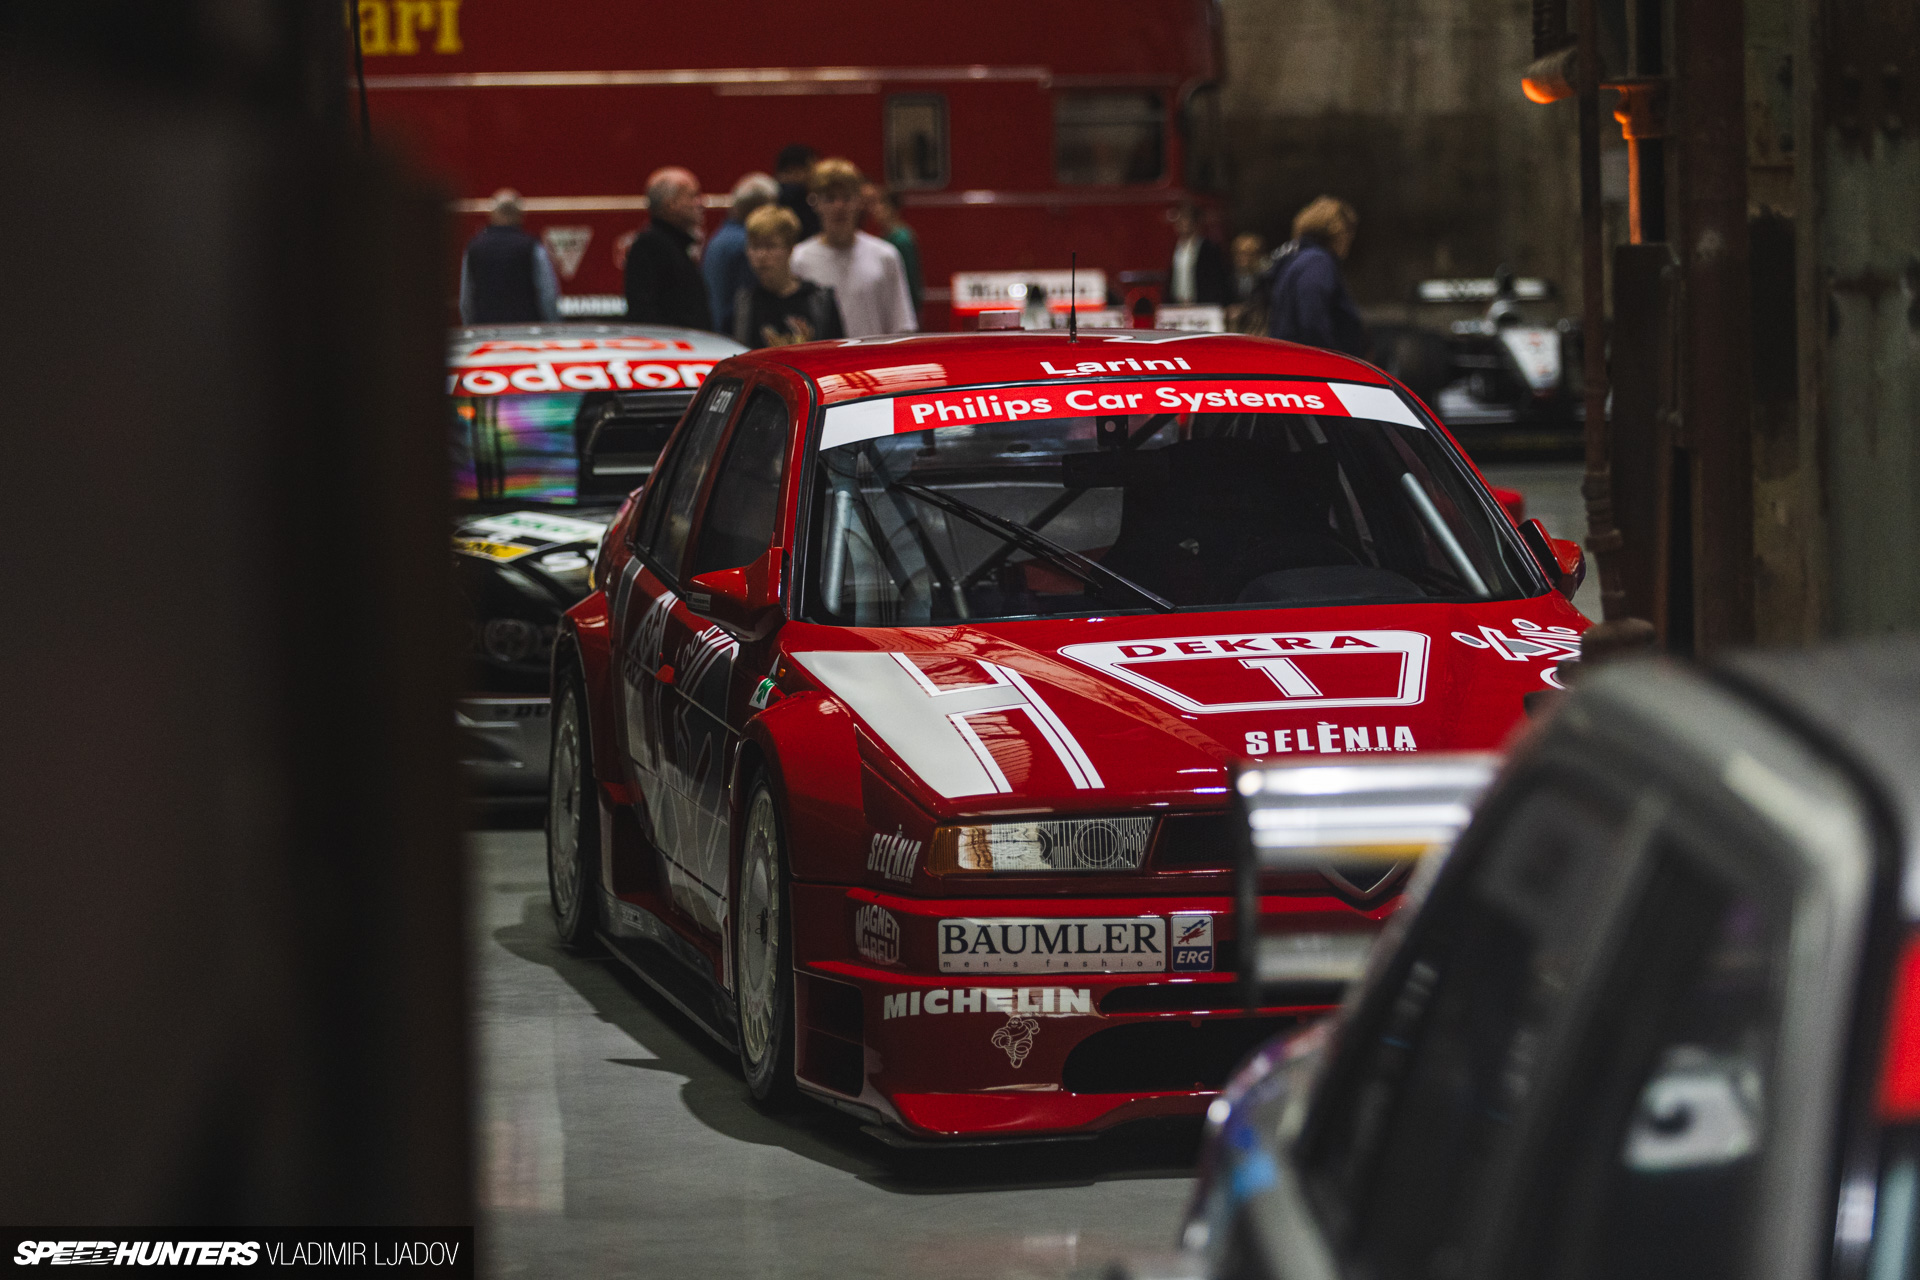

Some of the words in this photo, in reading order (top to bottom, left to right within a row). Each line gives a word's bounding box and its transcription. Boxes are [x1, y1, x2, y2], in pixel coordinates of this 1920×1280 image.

[344, 0, 464, 55] ari
[449, 361, 716, 395] odafon
[1040, 357, 1191, 375] Larini
[910, 395, 1052, 424] Philips
[1065, 390, 1143, 411] Car
[1155, 386, 1325, 412] Systems
[1118, 636, 1379, 656] DEKRA
[1237, 656, 1324, 698] 1
[1244, 721, 1417, 755] SELÈNIA
[943, 958, 1018, 968] men's
[1046, 958, 1162, 968] fashion
[1176, 950, 1210, 964] ERG
[884, 988, 1091, 1019] MICHELIN
